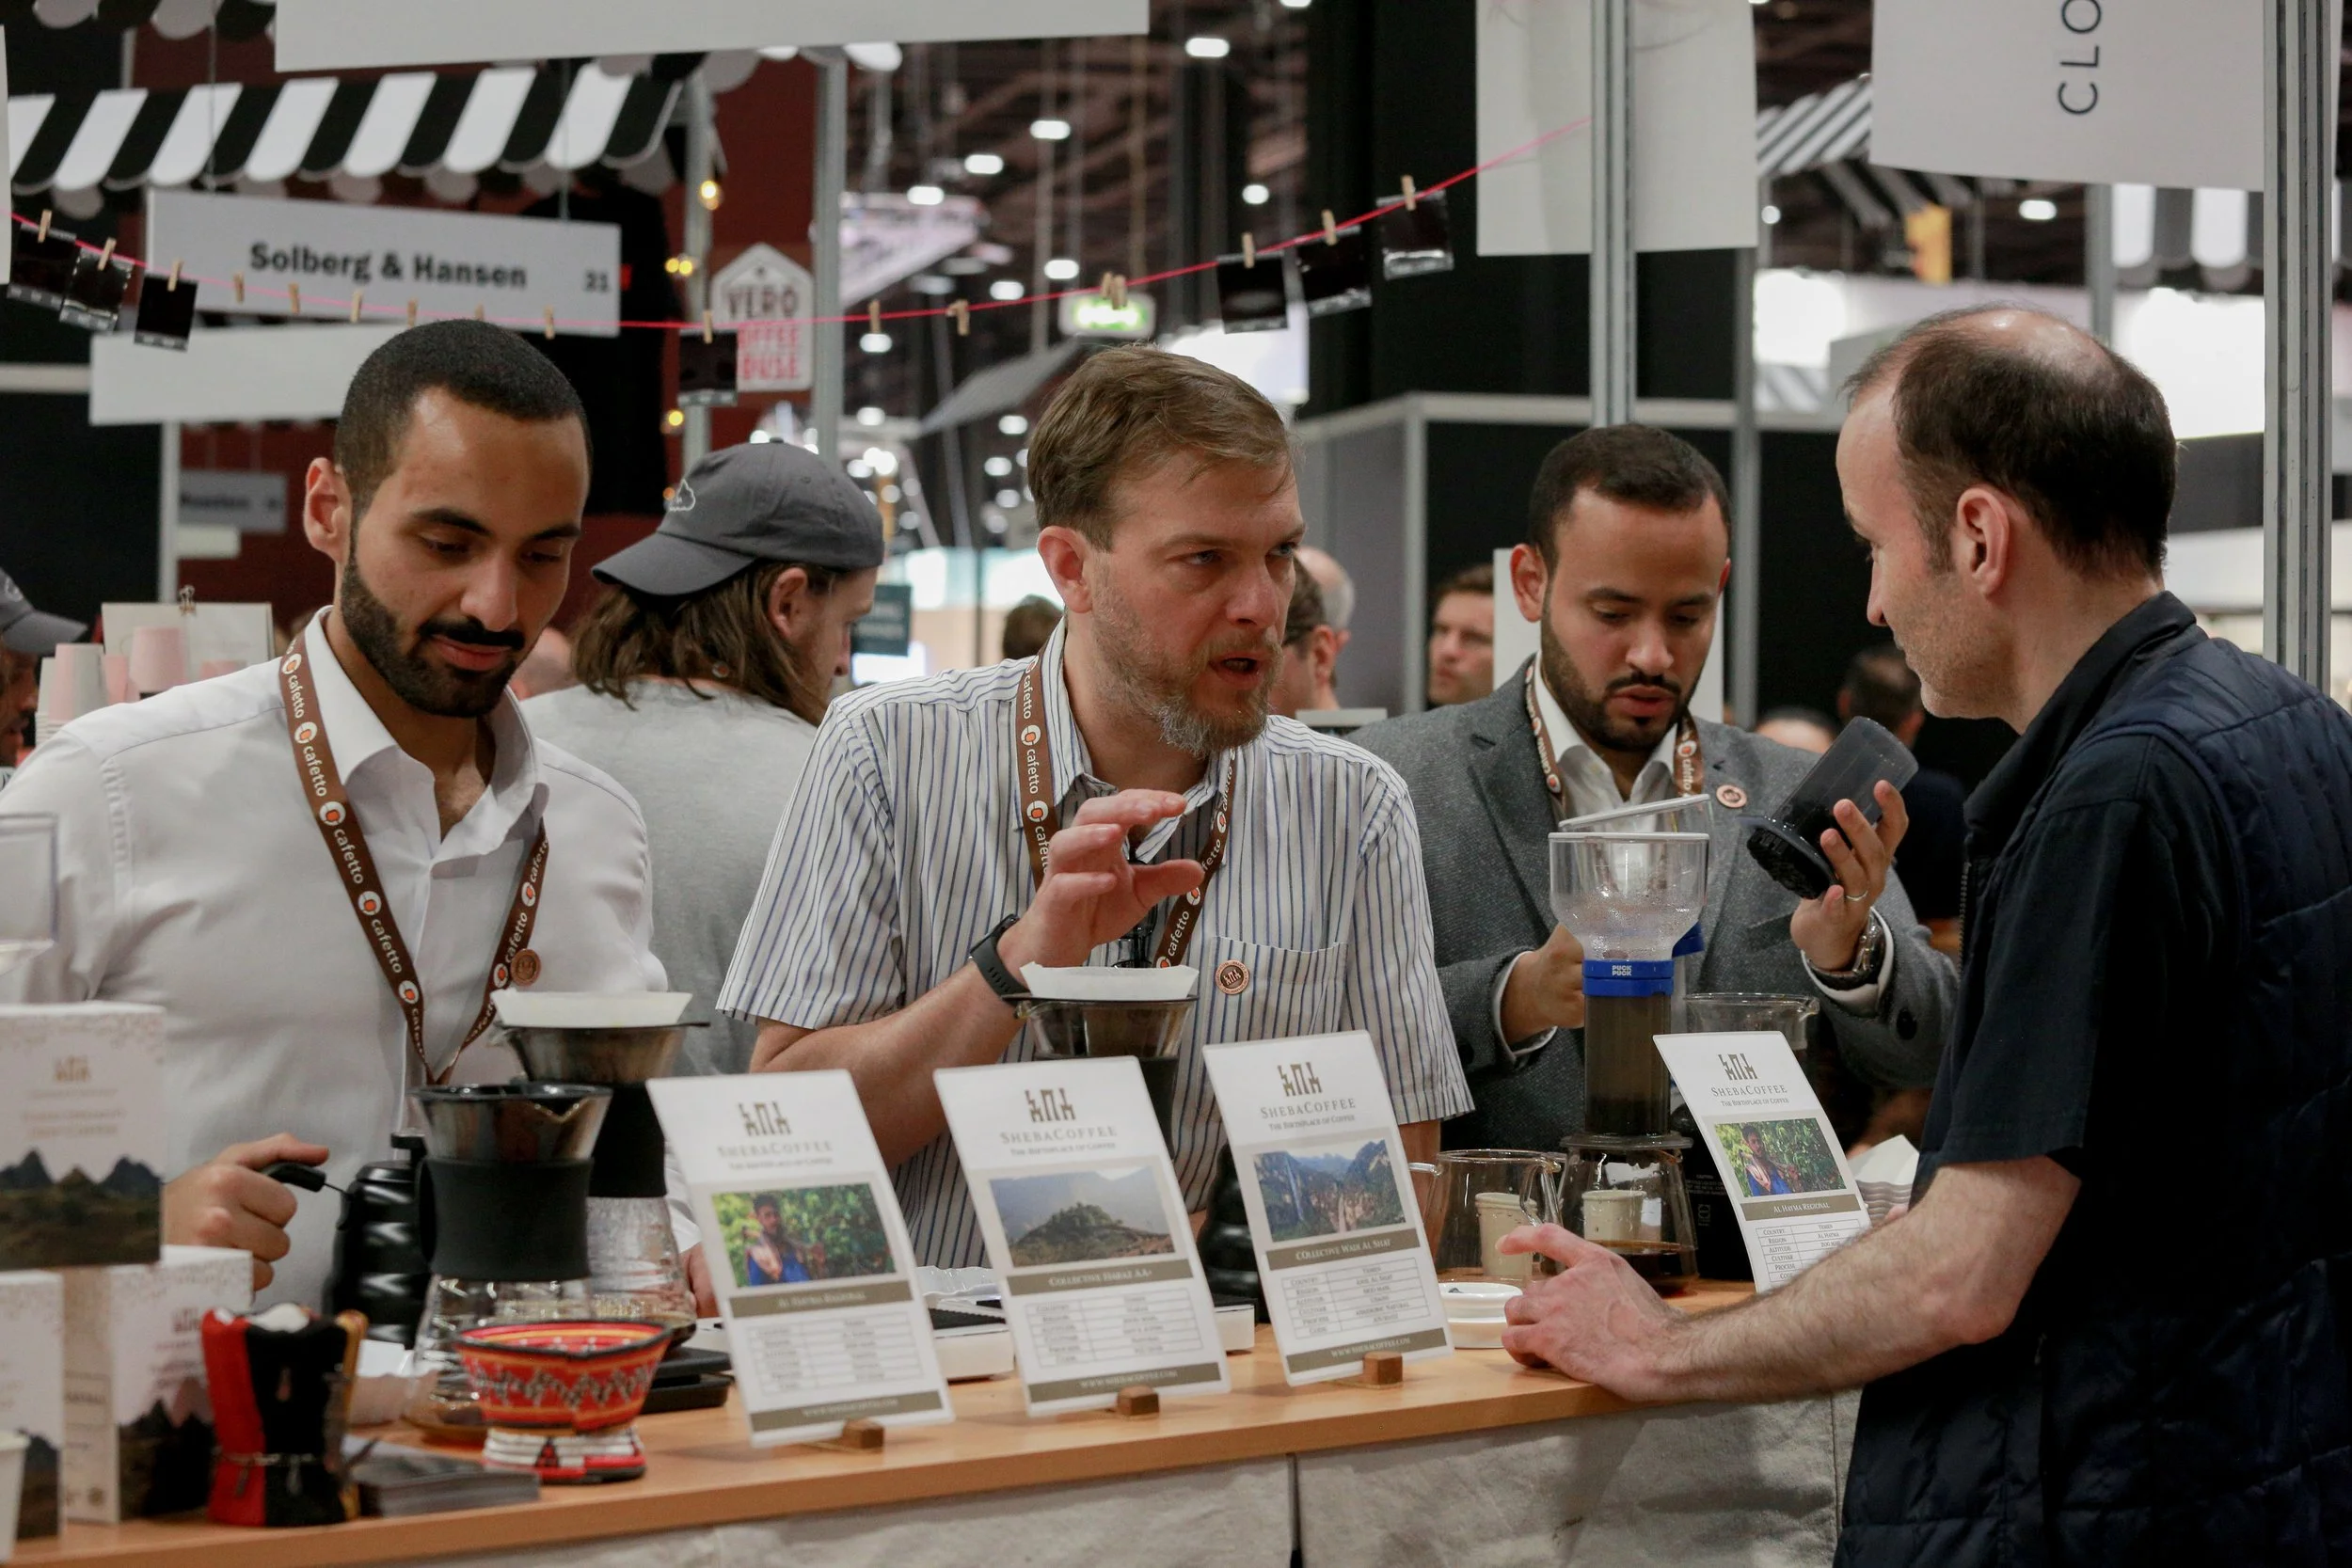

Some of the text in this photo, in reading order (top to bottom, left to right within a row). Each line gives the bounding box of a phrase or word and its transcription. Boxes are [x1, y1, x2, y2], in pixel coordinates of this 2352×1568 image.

[2058, 0, 2102, 116] CLO
[250, 242, 528, 290] Solberg & Hansen
[288, 673, 306, 720] cafetto
[1023, 674, 1034, 720] cafetto
[303, 744, 328, 798] cafetto
[1026, 749, 1040, 794] cafetto
[333, 828, 364, 885] cafetto
[1201, 838, 1221, 871] fetto
[371, 918, 403, 974] cafetto
[504, 911, 528, 964] cafetto
[1168, 911, 1190, 957] cafetto
